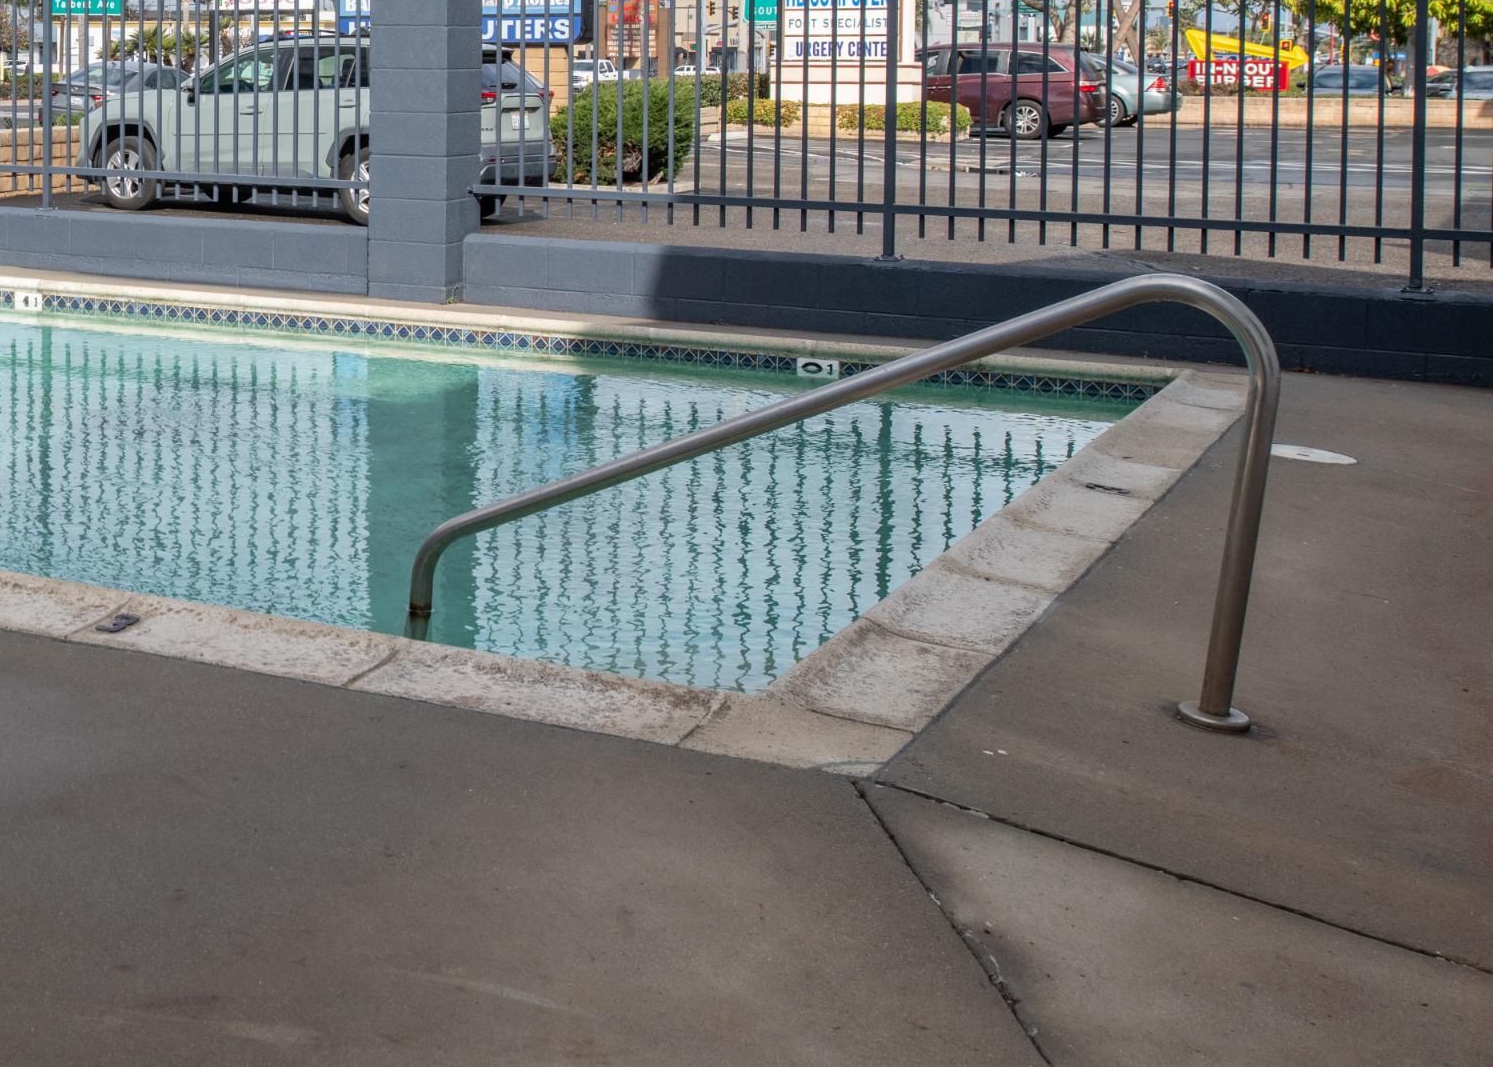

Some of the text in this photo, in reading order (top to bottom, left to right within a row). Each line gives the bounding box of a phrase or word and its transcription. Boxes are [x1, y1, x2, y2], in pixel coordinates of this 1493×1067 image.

[55, 0, 91, 8] Tabert
[482, 19, 570, 40] UTERS
[789, 17, 888, 29] FOT SECILIST
[848, 40, 888, 57] CENTE
